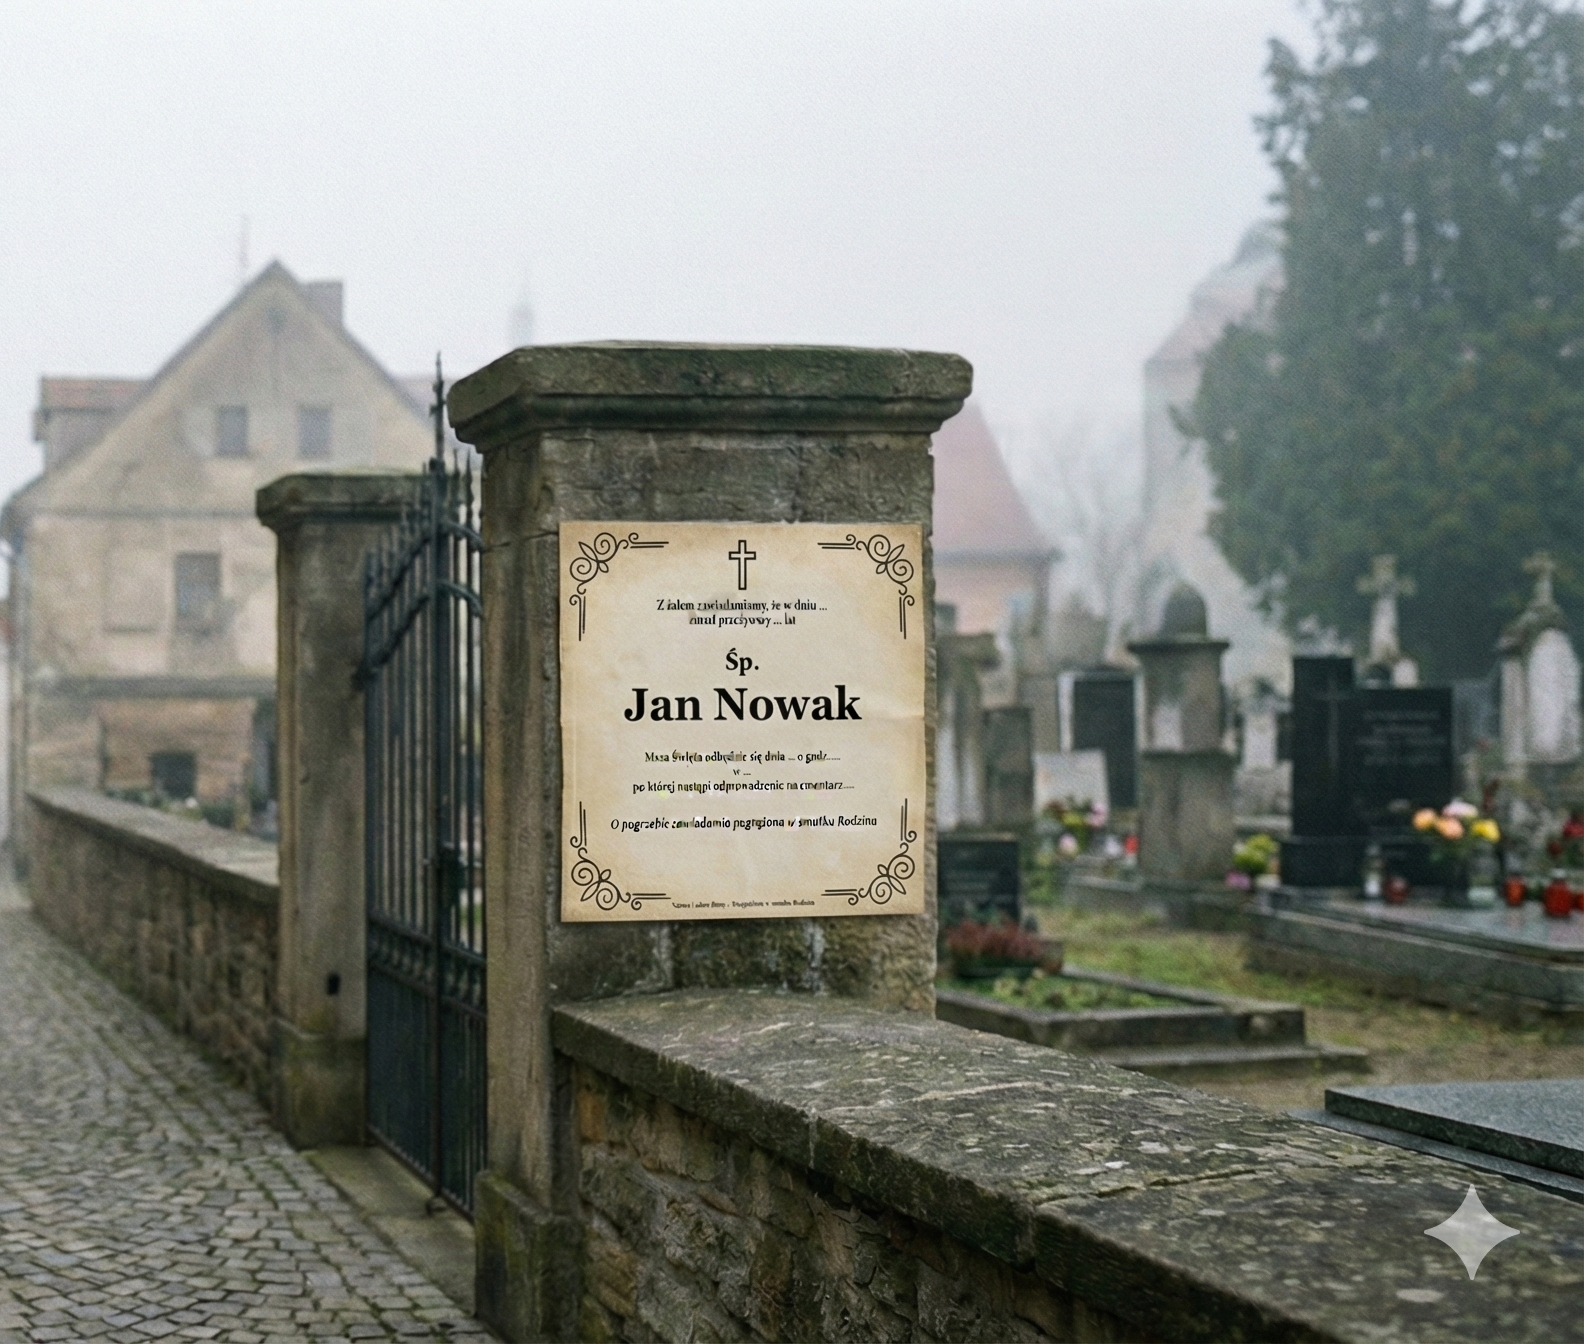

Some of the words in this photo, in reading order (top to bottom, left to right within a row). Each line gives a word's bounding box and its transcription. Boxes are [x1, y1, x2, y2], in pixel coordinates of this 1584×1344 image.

[656, 599, 665, 611] Z
[794, 599, 817, 611] dniu
[725, 647, 760, 676] Śp.
[624, 688, 703, 722] Jan
[713, 685, 863, 722] Nowak
[750, 751, 763, 764] się
[797, 753, 804, 762] o
[611, 818, 620, 829] O
